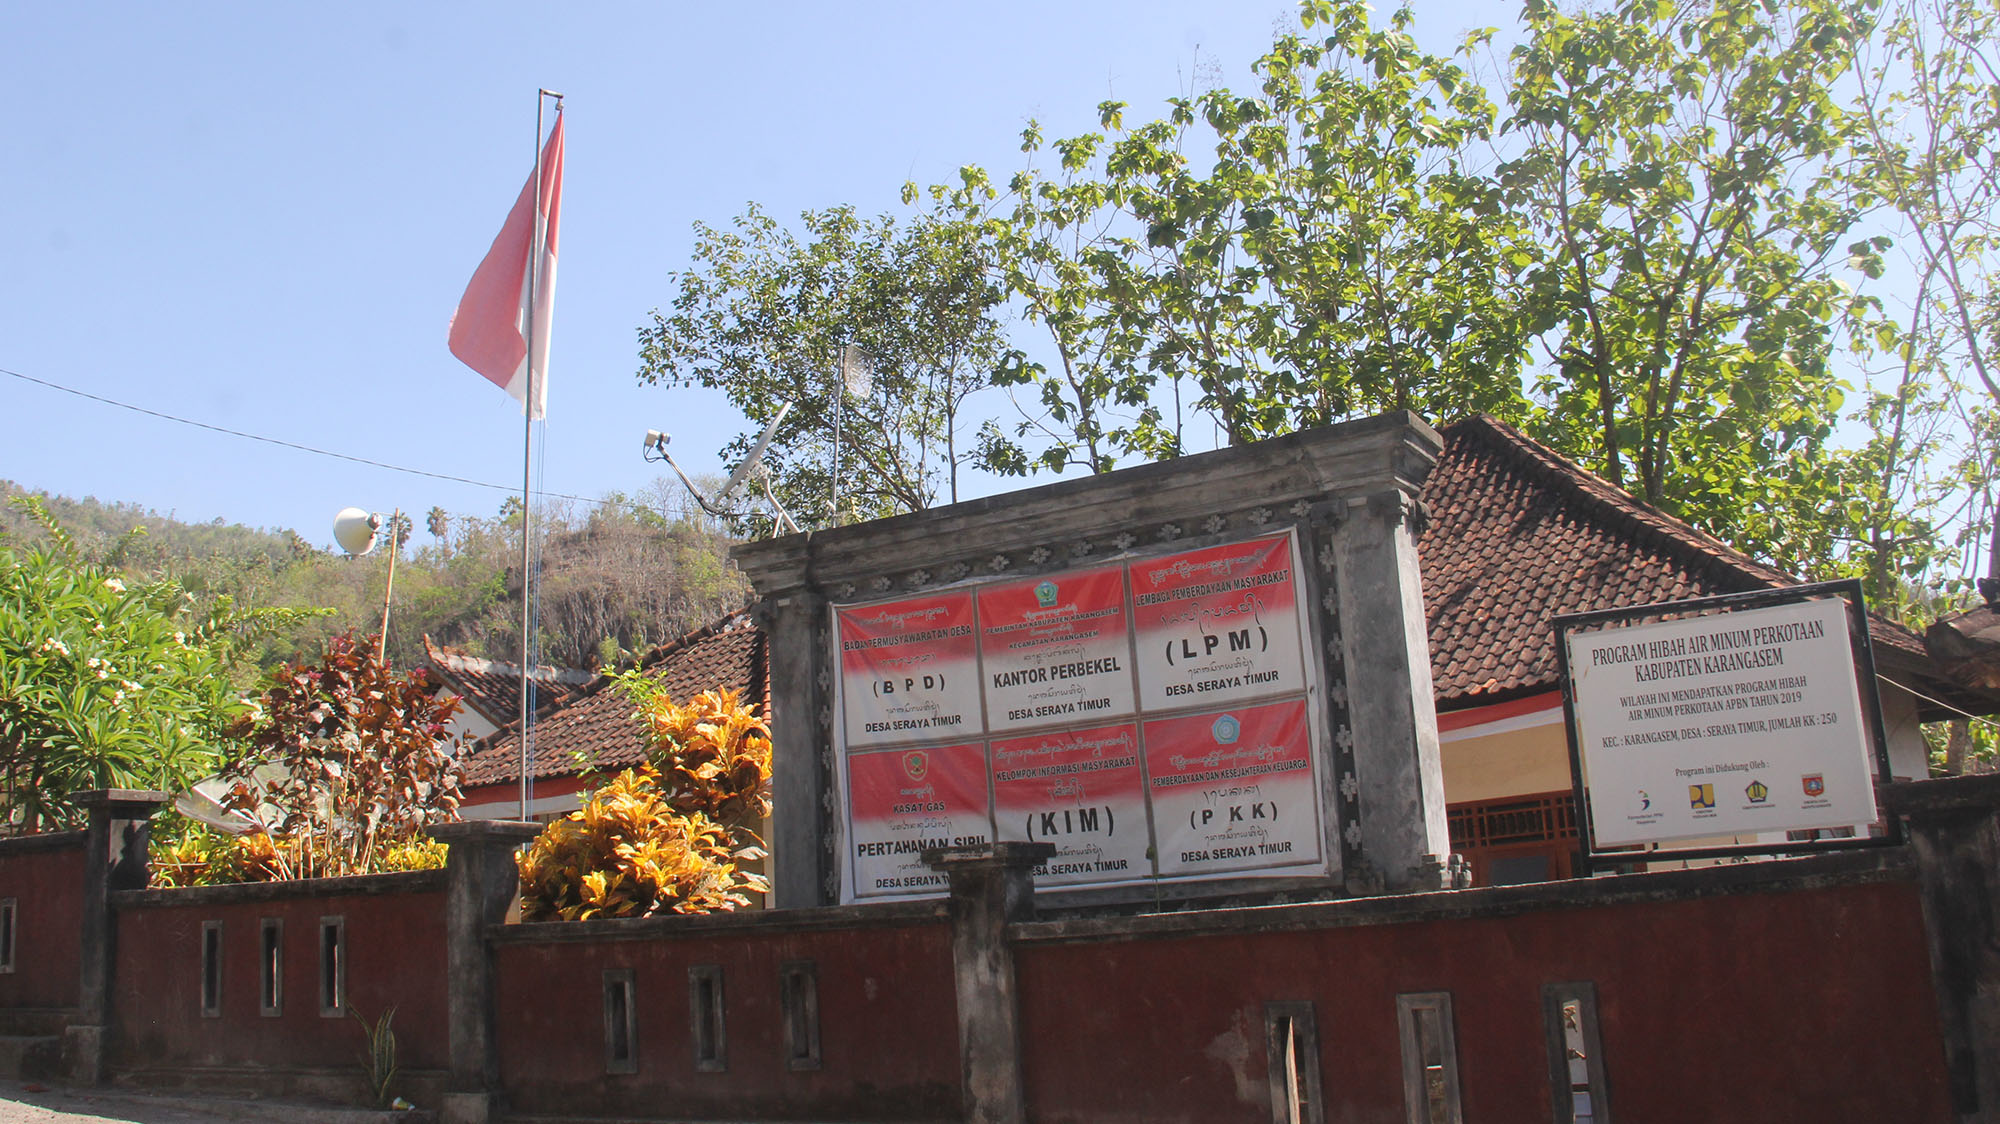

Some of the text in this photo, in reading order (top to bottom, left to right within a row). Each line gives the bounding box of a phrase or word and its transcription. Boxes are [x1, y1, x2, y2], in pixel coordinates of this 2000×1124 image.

[1136, 570, 1288, 607] LEMBAGA PEMBERDAYAAN MASYARAKAT
[985, 622, 1028, 634] PEMERINTAH
[1029, 616, 1069, 628] KABUPATEN
[1071, 608, 1118, 621] KARANGASEM
[869, 628, 949, 648] PERMUSYAWARATAN
[951, 625, 972, 636] DESA
[1009, 638, 1049, 649] KECAMATAN
[1050, 630, 1099, 643] KARANGASEM
[1592, 620, 1824, 666] PROGRAM HIBAH AIR MINUM PERKOTAAN
[994, 656, 1121, 689] KANTOR PERBEKEL
[1635, 647, 1784, 682] KABUPATEN KARANGASEM
[1166, 670, 1279, 697] DESA SERAYA TIMUR
[1620, 675, 1807, 707] WILAYAH INI MENDAPATKAN PROGRAM HIBAH
[1009, 698, 1111, 720] DESA SERAYA TIMUR
[1628, 691, 1802, 721] AIR MINUM PERKOTAAN APBN TAHUN 2019
[866, 715, 962, 732] DESA SERAYA TIMUR
[1624, 730, 1681, 746] KARANGASEM,
[1681, 727, 1702, 740] DESA
[1706, 723, 1737, 738] SERAYA
[1737, 720, 1768, 734] TIMUR,
[1768, 716, 1802, 732] JUMLAH
[1802, 714, 1815, 727] KK
[1820, 712, 1838, 725] 250
[996, 756, 1136, 782] KELOMPOK INFORMASI MASYARAKAT
[1153, 759, 1308, 787] PEMBERDAYAAN DAN KESEJAHTERAAN KELUARGA
[1675, 767, 1705, 777] Program
[1705, 765, 1715, 774] ini
[1715, 762, 1749, 773] Didukung
[1749, 760, 1766, 770] Oleh
[893, 801, 945, 814] KASAT GAS
[857, 837, 949, 858] PERTAHANAN
[1181, 841, 1292, 863] DESA SERAYA TIMUR
[1032, 859, 1128, 876] ESA SERAYA TIMUR
[876, 878, 901, 889] DESA
[903, 875, 941, 887] SERAYA
